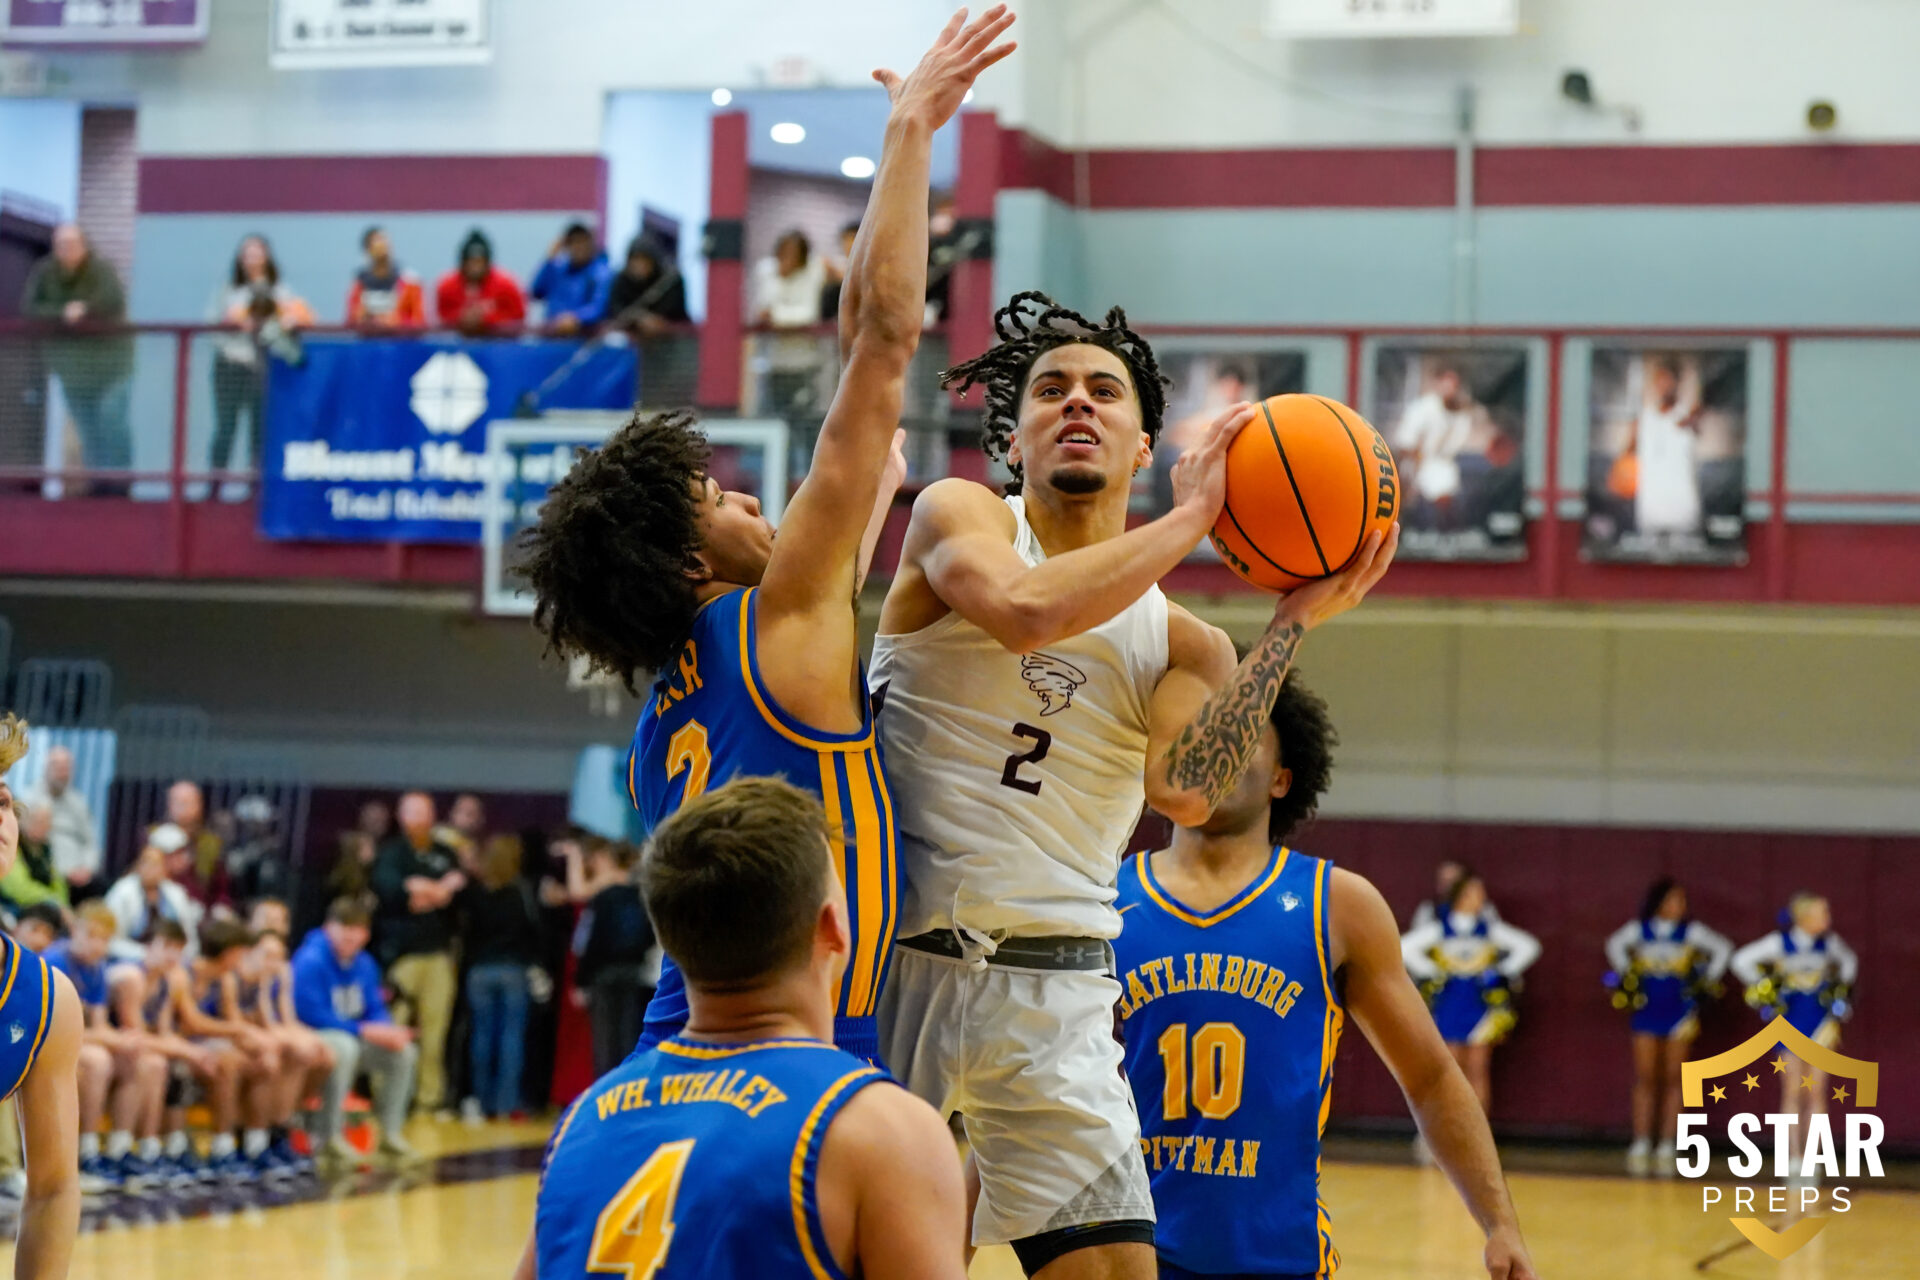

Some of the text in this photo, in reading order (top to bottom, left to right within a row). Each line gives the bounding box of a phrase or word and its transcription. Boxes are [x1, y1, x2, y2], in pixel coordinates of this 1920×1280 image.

[1000, 722, 1052, 796] 2
[596, 1069, 788, 1121] WH. WHALEY
[1158, 1021, 1246, 1121] 10
[586, 1138, 697, 1280] 4
